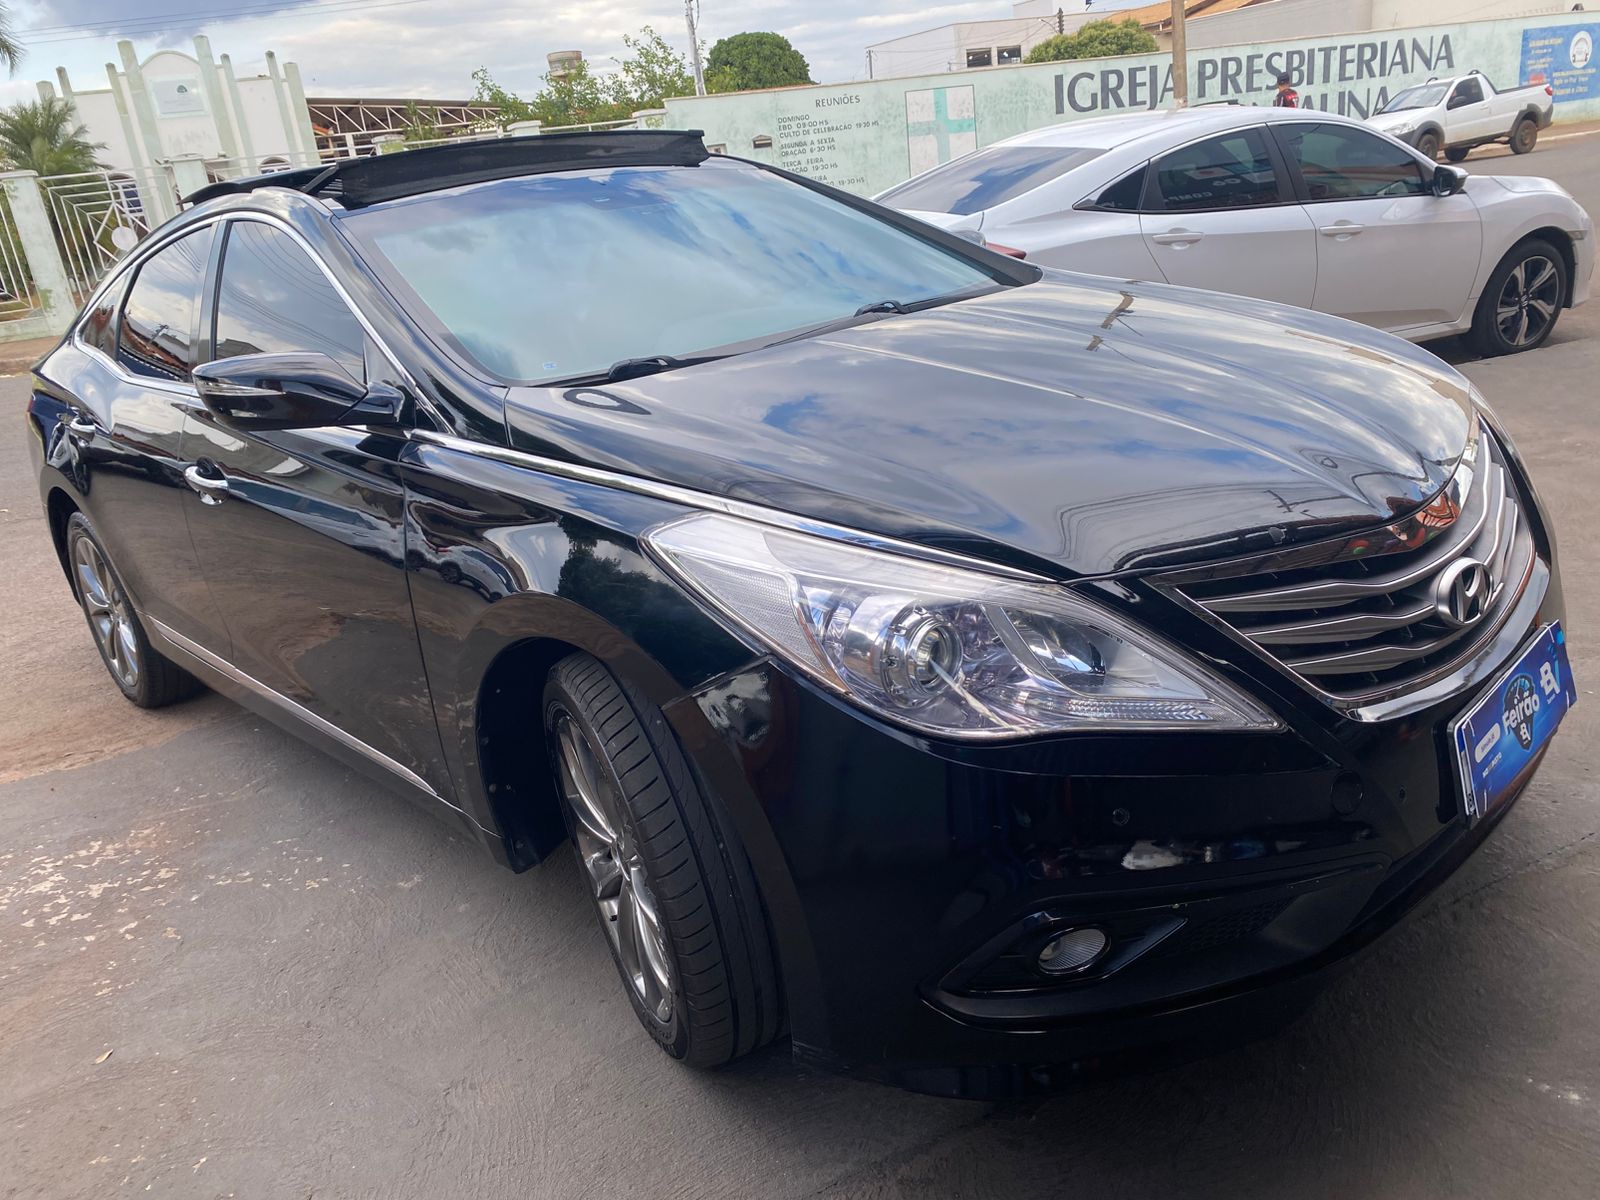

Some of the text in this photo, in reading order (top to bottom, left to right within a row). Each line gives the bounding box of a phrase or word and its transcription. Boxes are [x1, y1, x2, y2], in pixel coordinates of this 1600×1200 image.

[1055, 33, 1455, 115] IGREJA PRESBITERIANA
[815, 94, 861, 108] REUNIÕES
[777, 114, 810, 124] DOMINGO
[779, 130, 801, 139] CULTO
[780, 141, 808, 150] SEGUNDA
[817, 137, 835, 145] SEXTA
[806, 157, 824, 165] FEIRA
[1502, 690, 1540, 736] Feirão
